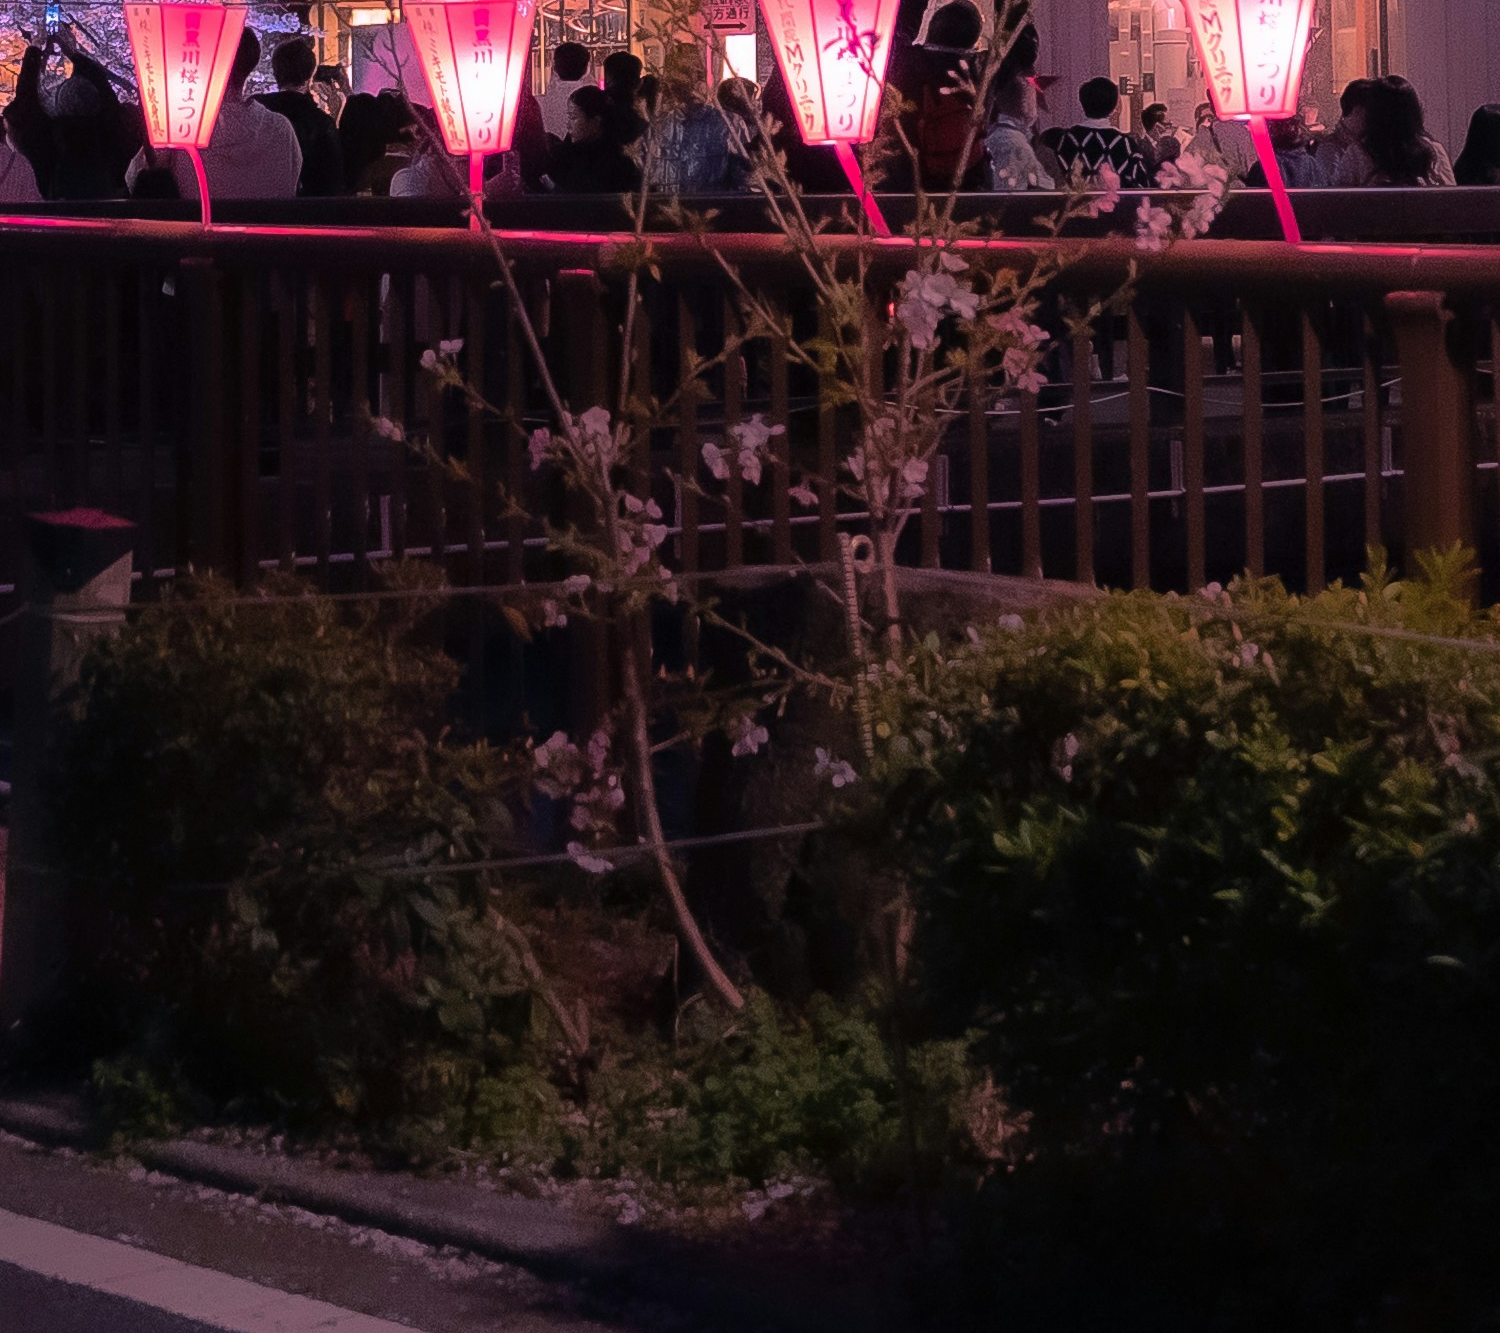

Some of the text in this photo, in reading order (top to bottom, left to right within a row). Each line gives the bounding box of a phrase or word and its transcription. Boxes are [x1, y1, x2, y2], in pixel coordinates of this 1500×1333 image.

[177, 12, 201, 139] 目黒川桜まつり
